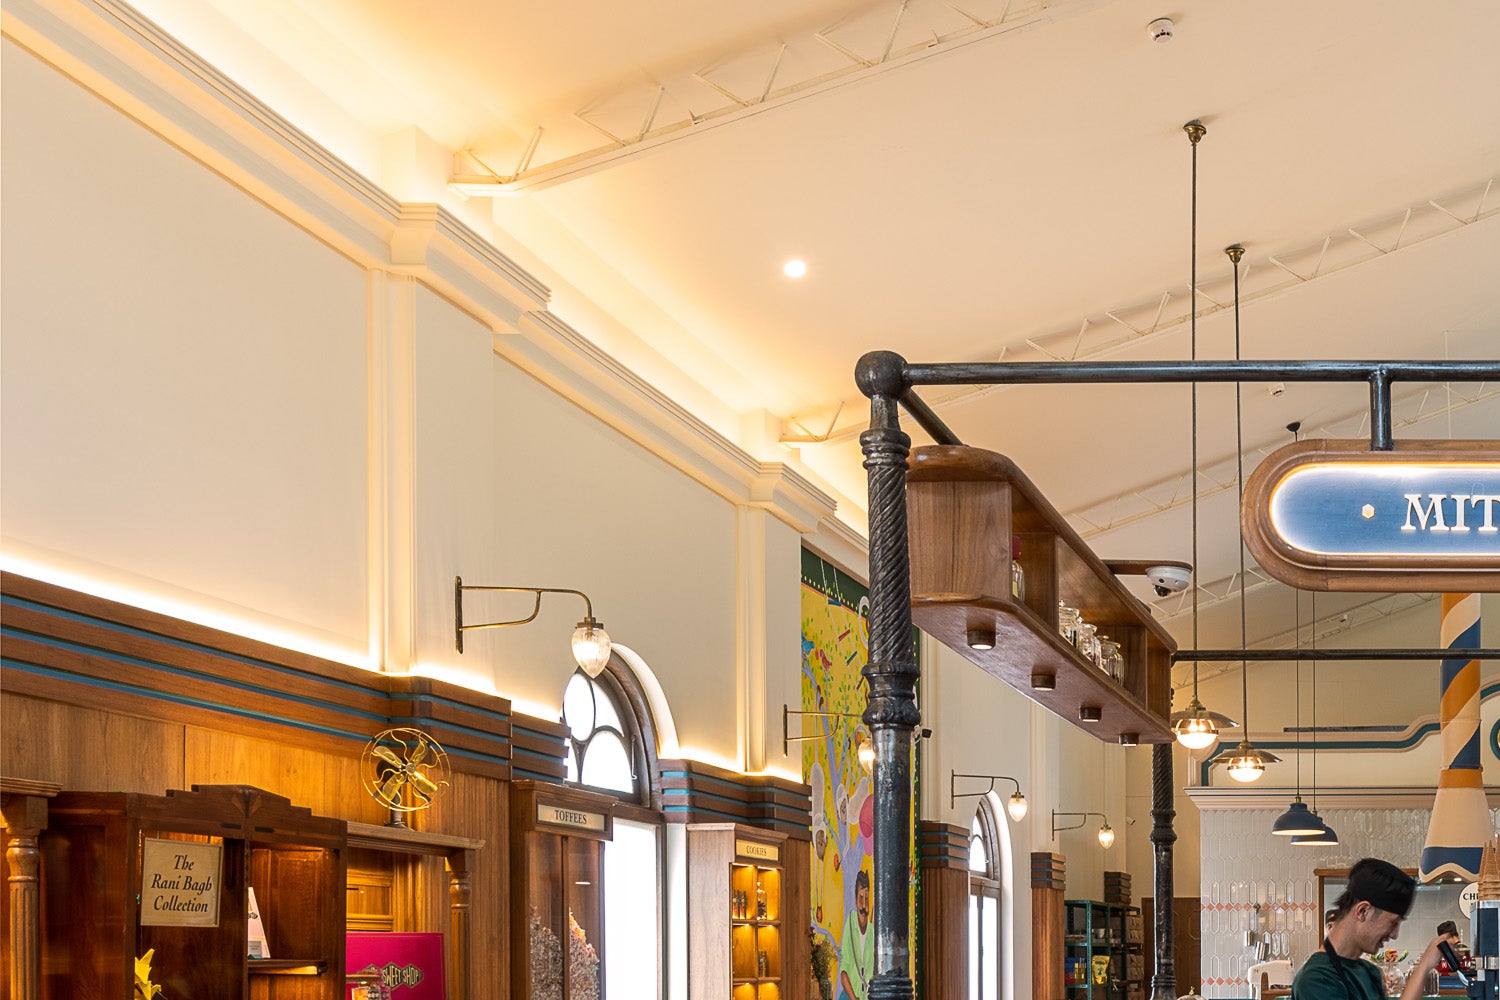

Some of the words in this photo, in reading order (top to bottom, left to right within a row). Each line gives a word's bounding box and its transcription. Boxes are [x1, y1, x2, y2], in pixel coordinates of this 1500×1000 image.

[554, 809, 587, 824] TOFFEES
[746, 845, 767, 857] COOKIES
[174, 854, 195, 871] The
[151, 873, 180, 890] Rani
[182, 875, 213, 896] Bagh
[153, 895, 209, 913] Collection
[382, 965, 401, 988] SWEET
[402, 966, 419, 986] SHOP
